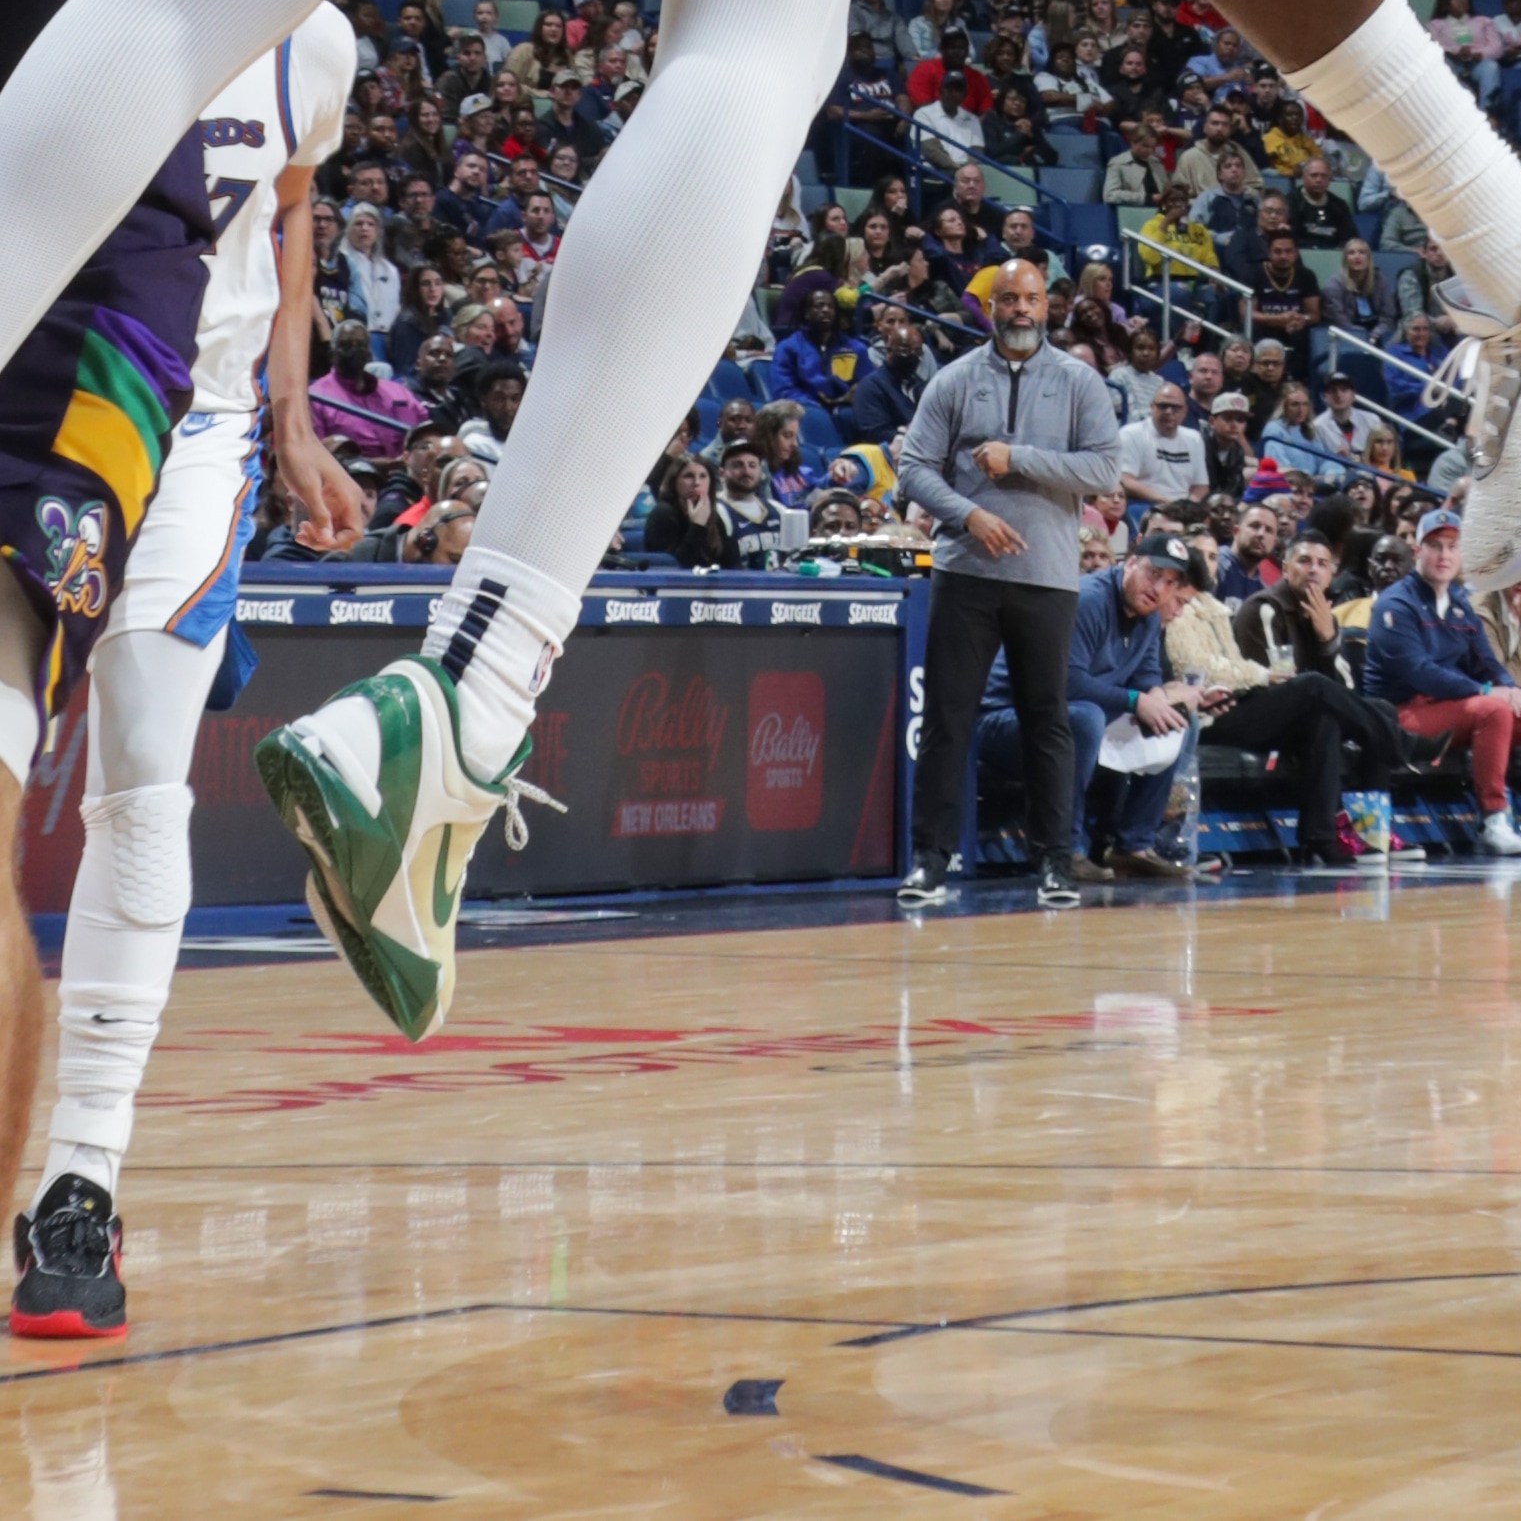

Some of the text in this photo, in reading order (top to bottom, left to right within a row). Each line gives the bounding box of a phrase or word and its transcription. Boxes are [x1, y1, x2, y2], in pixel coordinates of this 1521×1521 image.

[199, 173, 259, 256] 7
[235, 598, 294, 624] EATGEEK
[329, 599, 394, 625] SEATGEEK
[605, 599, 661, 624] SEATGEEK
[689, 600, 744, 625] SEATGEEK
[770, 601, 822, 625] SEATGEEK
[848, 602, 899, 626] SEATGEEK
[616, 670, 729, 773] Bally
[751, 711, 821, 776] Bally
[639, 759, 700, 793] SPORTS
[765, 767, 803, 790] SPORTS
[620, 801, 717, 834] NEW ORLEANS
